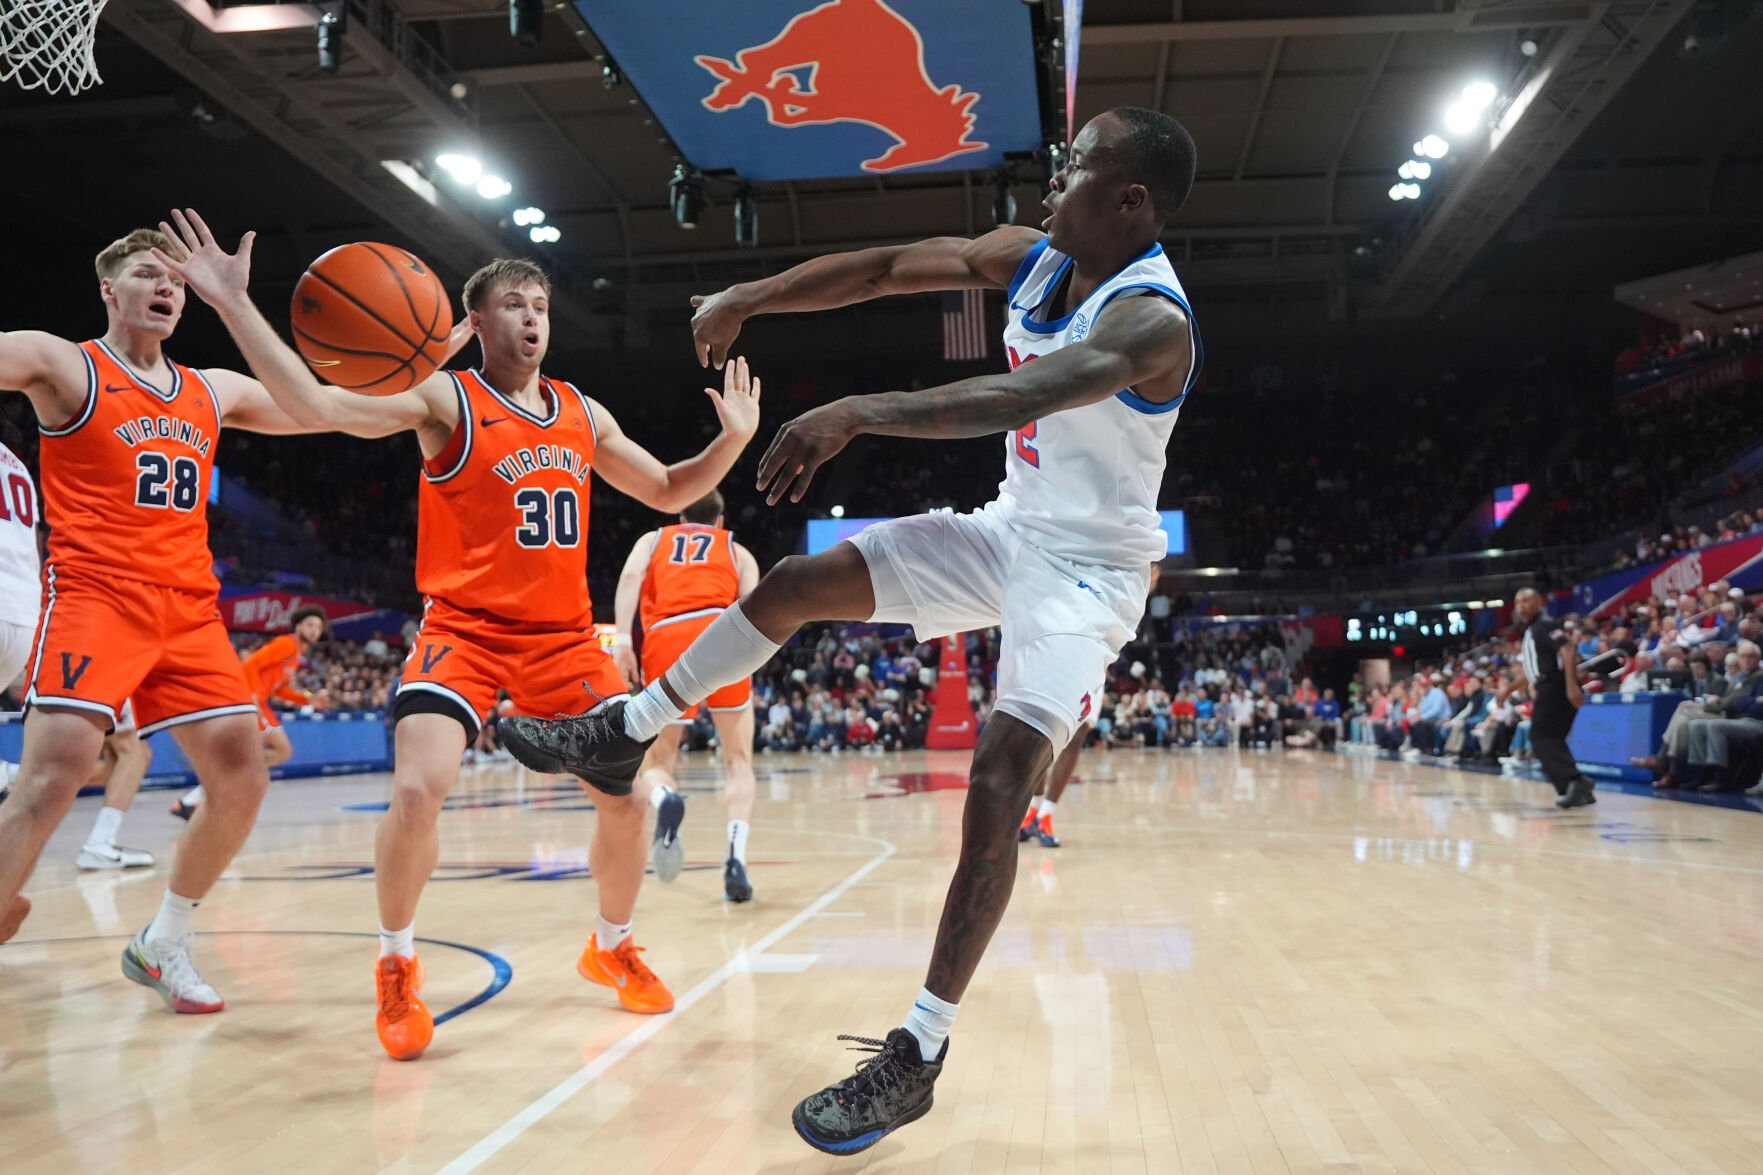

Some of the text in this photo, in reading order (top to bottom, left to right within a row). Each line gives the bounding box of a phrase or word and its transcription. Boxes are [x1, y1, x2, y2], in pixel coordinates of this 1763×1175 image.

[114, 416, 210, 459] VIRGINIA
[134, 451, 200, 514] 28
[492, 444, 591, 486] VIRGINIA
[514, 487, 580, 549] 30
[671, 532, 716, 566] 17
[60, 651, 92, 691] V
[420, 643, 453, 674] V
